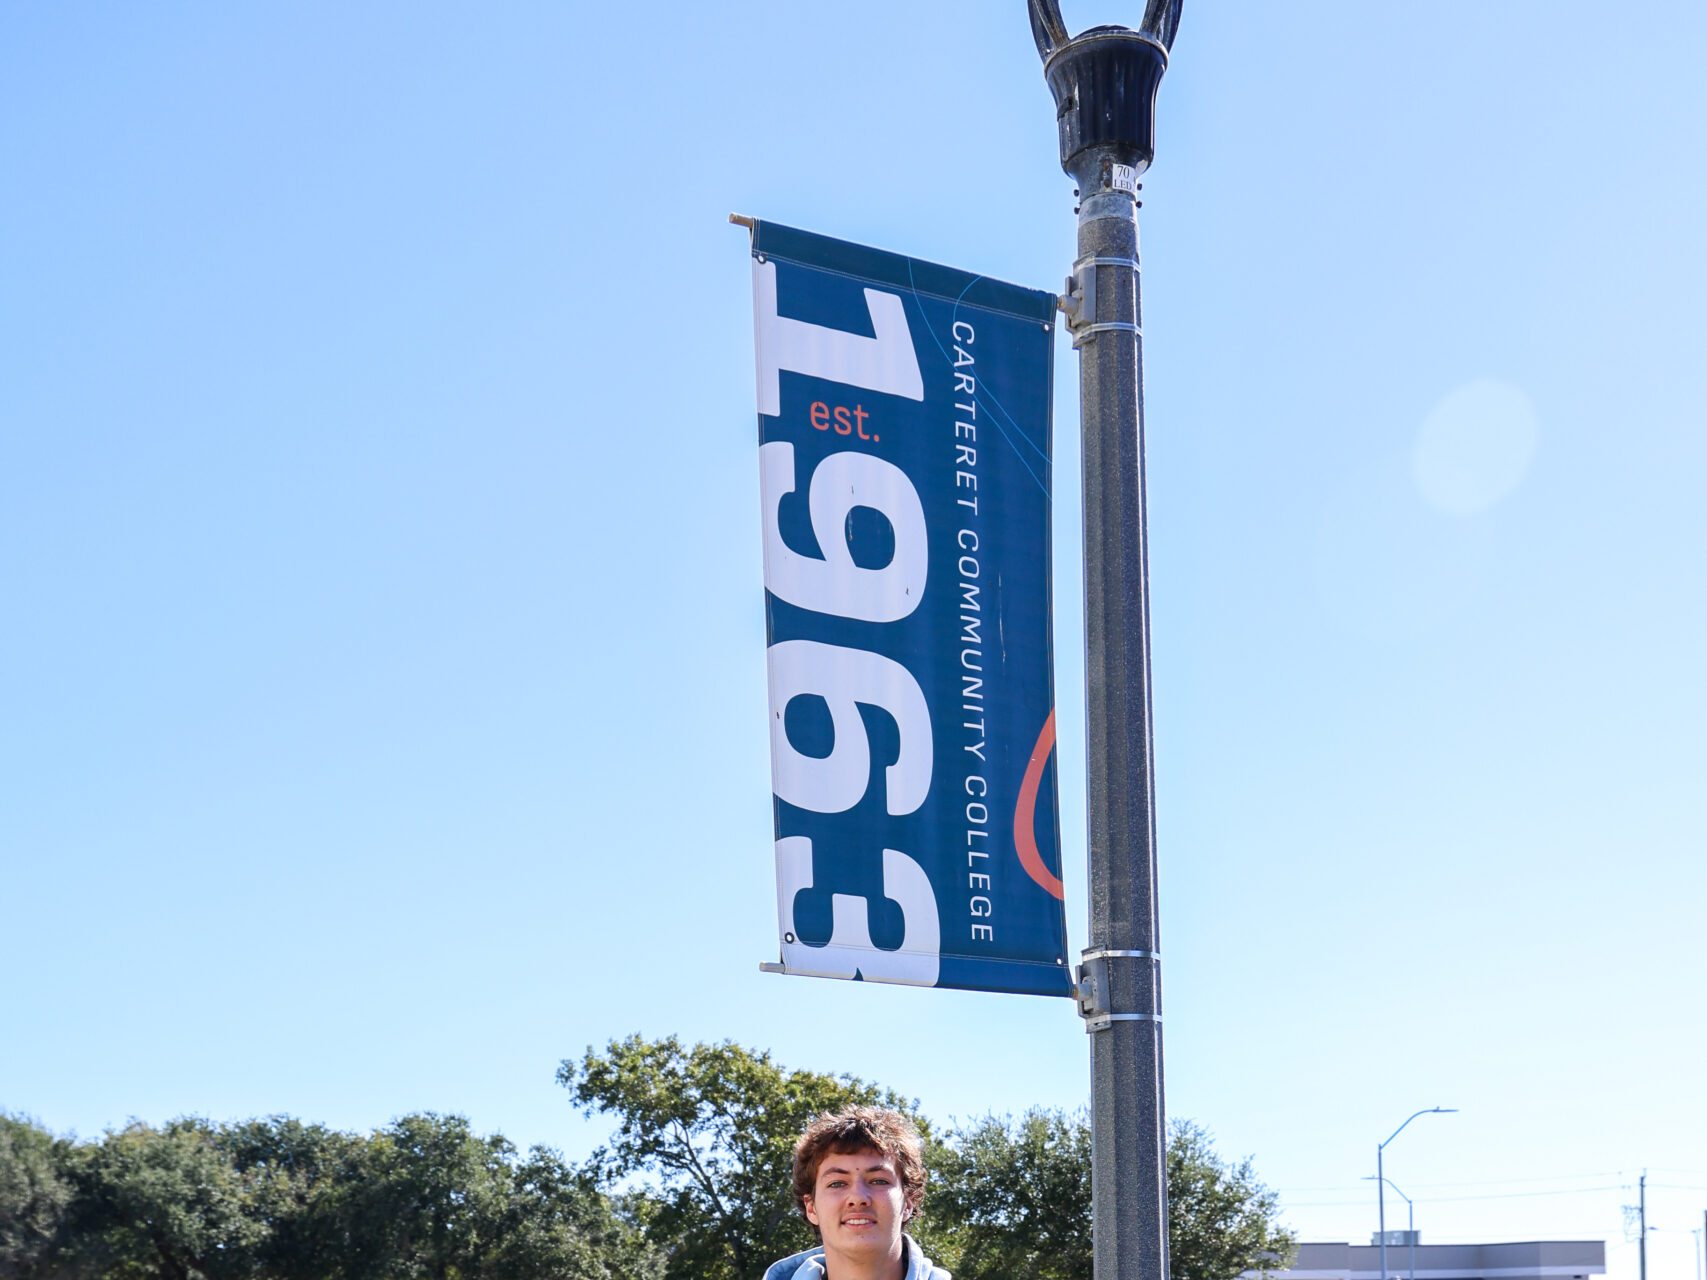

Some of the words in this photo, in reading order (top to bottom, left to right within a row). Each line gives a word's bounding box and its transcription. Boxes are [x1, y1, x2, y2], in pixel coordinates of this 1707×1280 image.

[1114, 179, 1132, 190] LED
[1117, 165, 1130, 179] 70
[810, 401, 880, 442] est.
[952, 320, 978, 516] CARTERET
[752, 257, 942, 988] 1963
[957, 529, 986, 762] COMMUNITY
[965, 775, 993, 942] COLLEGE
